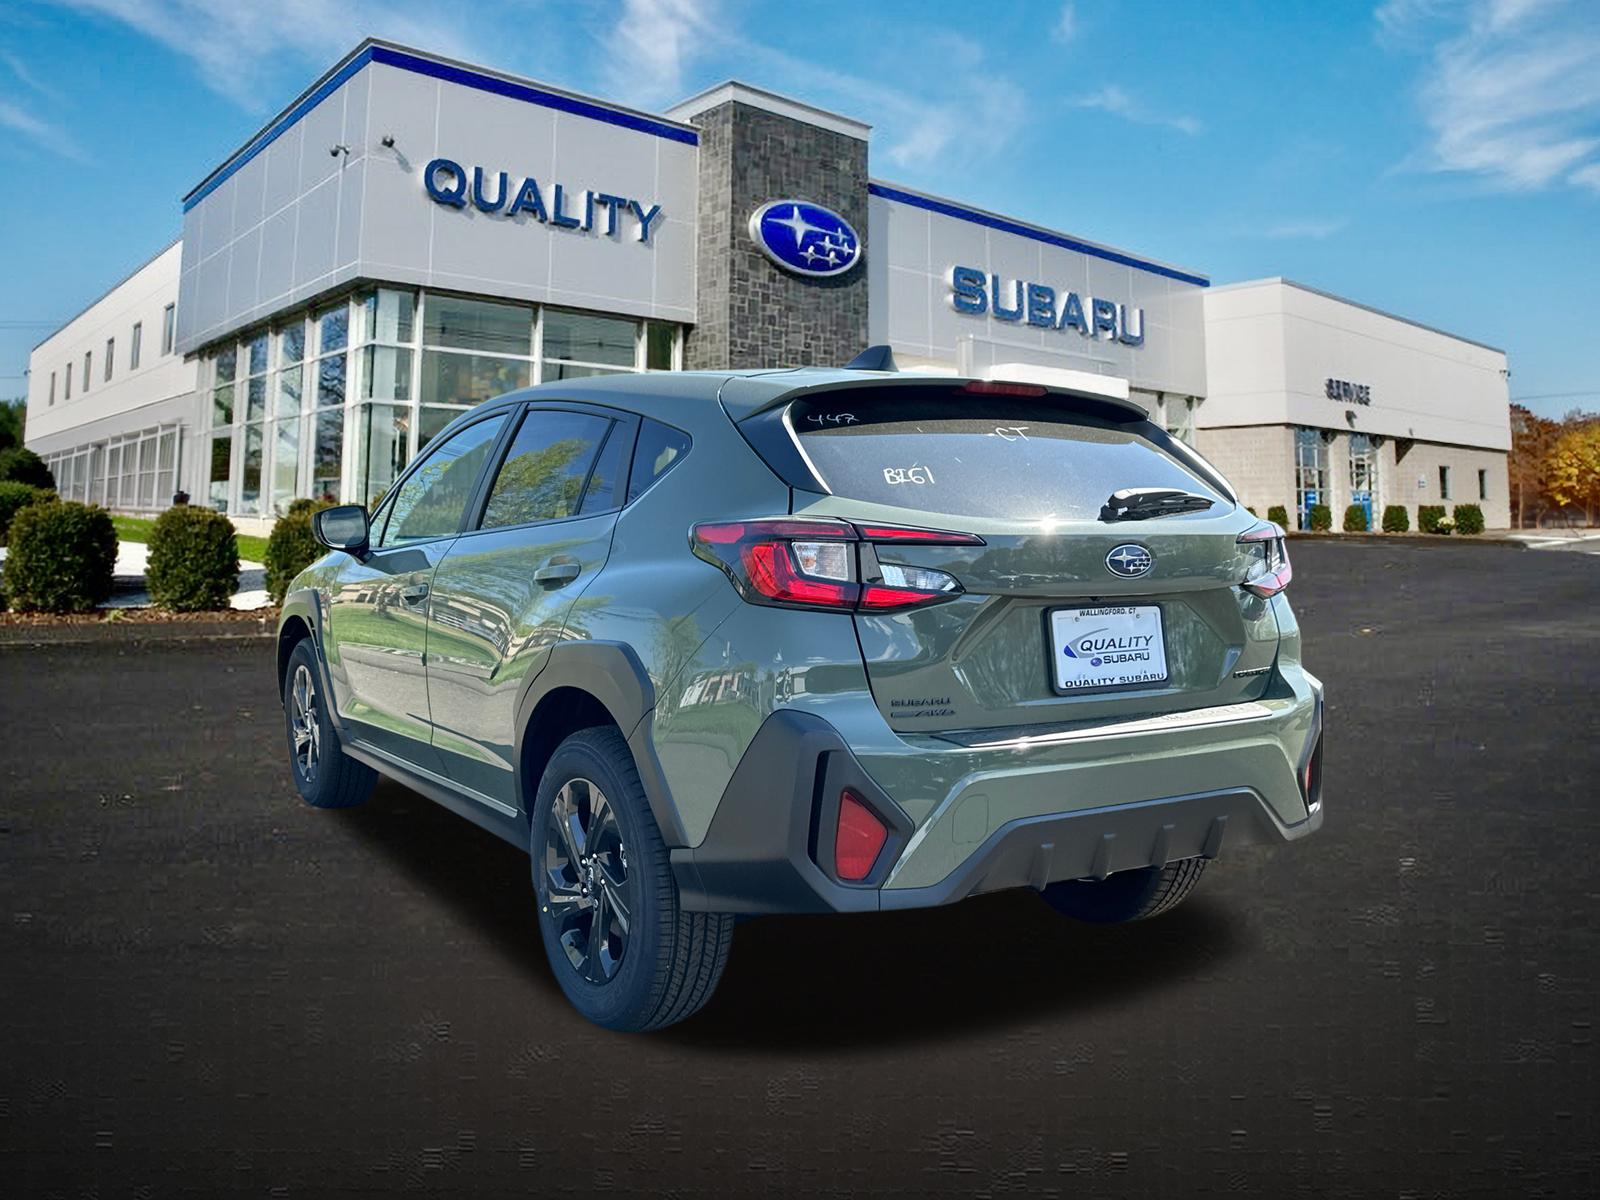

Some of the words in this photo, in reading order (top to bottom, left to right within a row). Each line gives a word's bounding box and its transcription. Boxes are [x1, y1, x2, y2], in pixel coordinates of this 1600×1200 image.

[423, 158, 661, 243] QUALITY
[951, 265, 1145, 346] SUBARU
[1326, 378, 1371, 406] SERVICE
[1080, 635, 1154, 652] QUALITY
[1103, 652, 1150, 664] SUBARU
[1065, 677, 1116, 688] QUALITY
[1119, 673, 1165, 684] SUBARU
[891, 698, 951, 707] SUBARU
